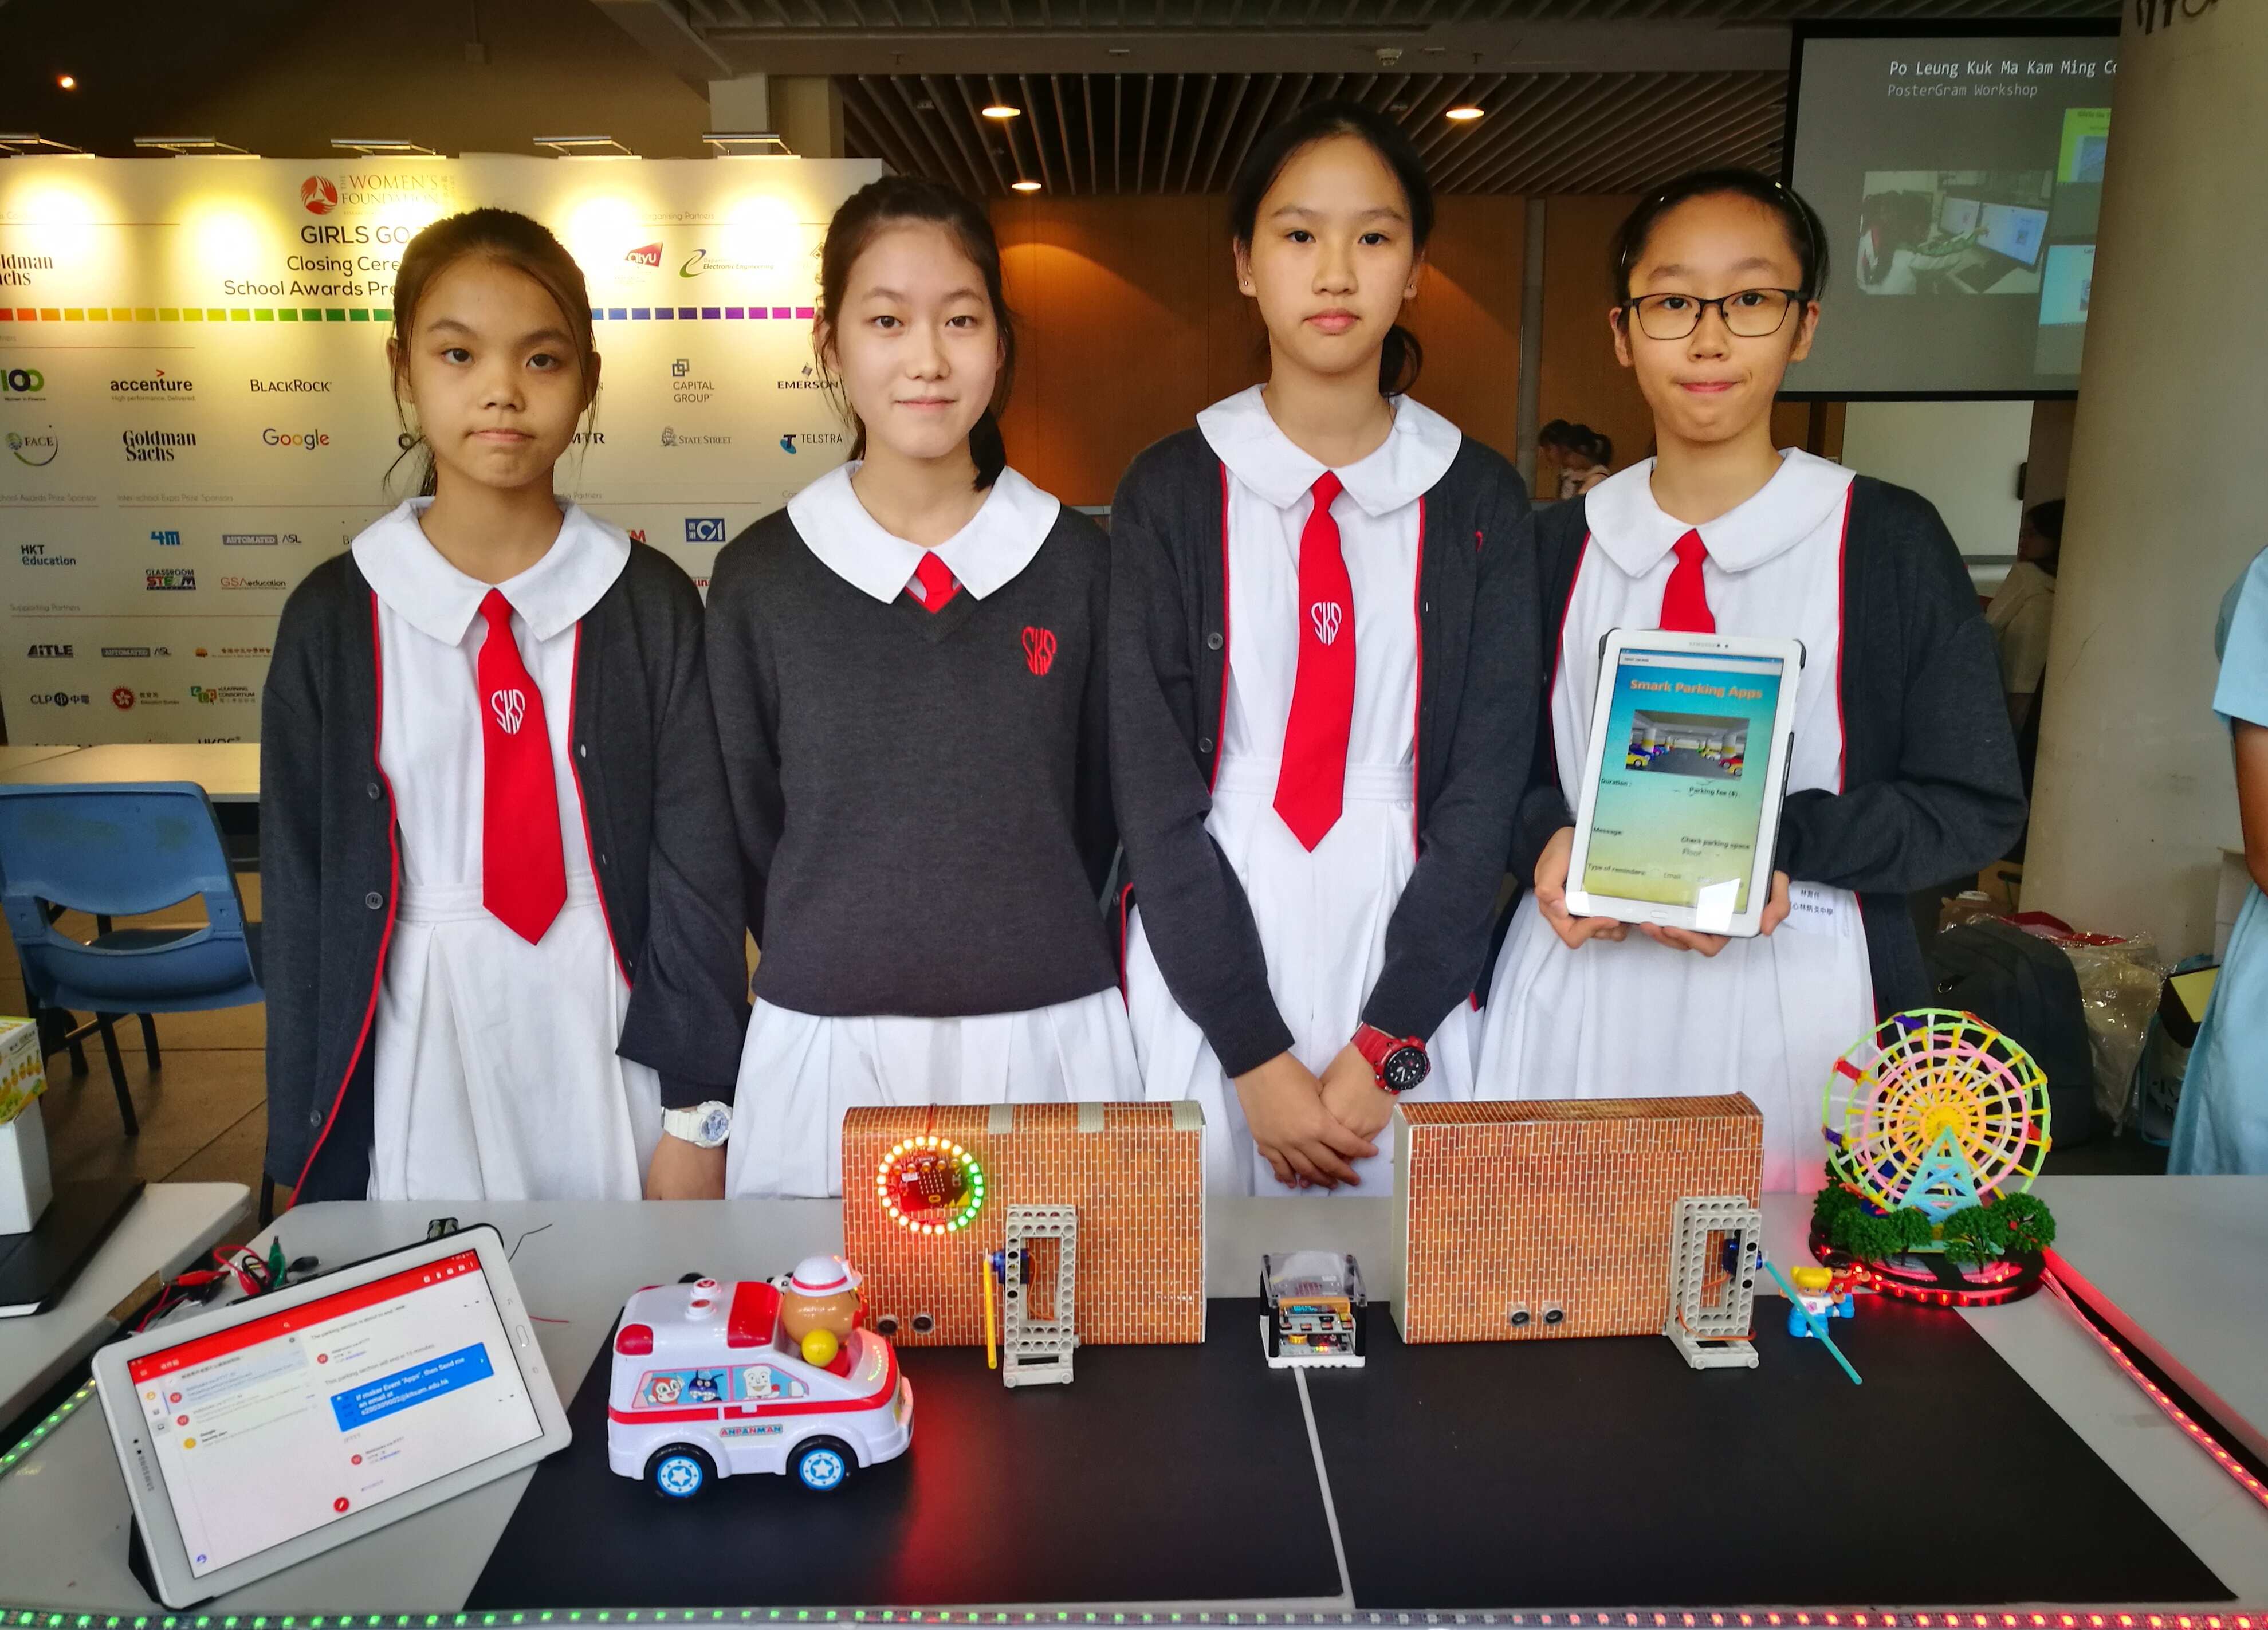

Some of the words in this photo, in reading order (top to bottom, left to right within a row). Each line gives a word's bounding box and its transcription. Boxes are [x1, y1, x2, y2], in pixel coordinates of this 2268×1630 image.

[1890, 61, 1907, 76] Po
[1916, 61, 1958, 78] Leung
[1967, 61, 1992, 76] Kuk
[2001, 61, 2018, 75] Ma
[2027, 60, 2053, 74] Kam
[2061, 59, 2095, 77] Ming
[1888, 83, 1967, 96] PosterGram
[1975, 83, 2037, 98] Workshop
[349, 174, 438, 190] WOMEN'S
[685, 211, 714, 219] Partners
[301, 226, 369, 244] GIRLS
[0, 254, 54, 270] ldman
[286, 256, 353, 277] Closing
[357, 256, 402, 271] Cere
[224, 280, 284, 295] School
[289, 281, 363, 296] Awards
[110, 378, 193, 391] accenture
[673, 381, 716, 390] CAPITAL
[777, 380, 839, 390] EMERSON
[674, 394, 710, 403] GROUP
[123, 430, 197, 446] Goldman
[262, 427, 331, 450] Google
[800, 433, 843, 444] TELSTRA
[125, 446, 175, 462] Sachs
[226, 536, 276, 544] AUTOMATED
[21, 545, 45, 555] HKT
[10, 603, 50, 612] Supporting
[52, 603, 81, 611] Partners
[1630, 679, 1671, 692] Smark
[1675, 682, 1725, 698] Parking
[1728, 686, 1763, 700] Apps
[30, 694, 53, 705] CLP
[1689, 786, 1715, 796] Parking
[363, 1386, 383, 1399] maker
[383, 1381, 401, 1391] Event
[424, 1366, 439, 1376] then
[439, 1361, 454, 1372] Send
[455, 1357, 465, 1365] me
[368, 1393, 386, 1405] email
[719, 1424, 783, 1437] ANPANMAN
